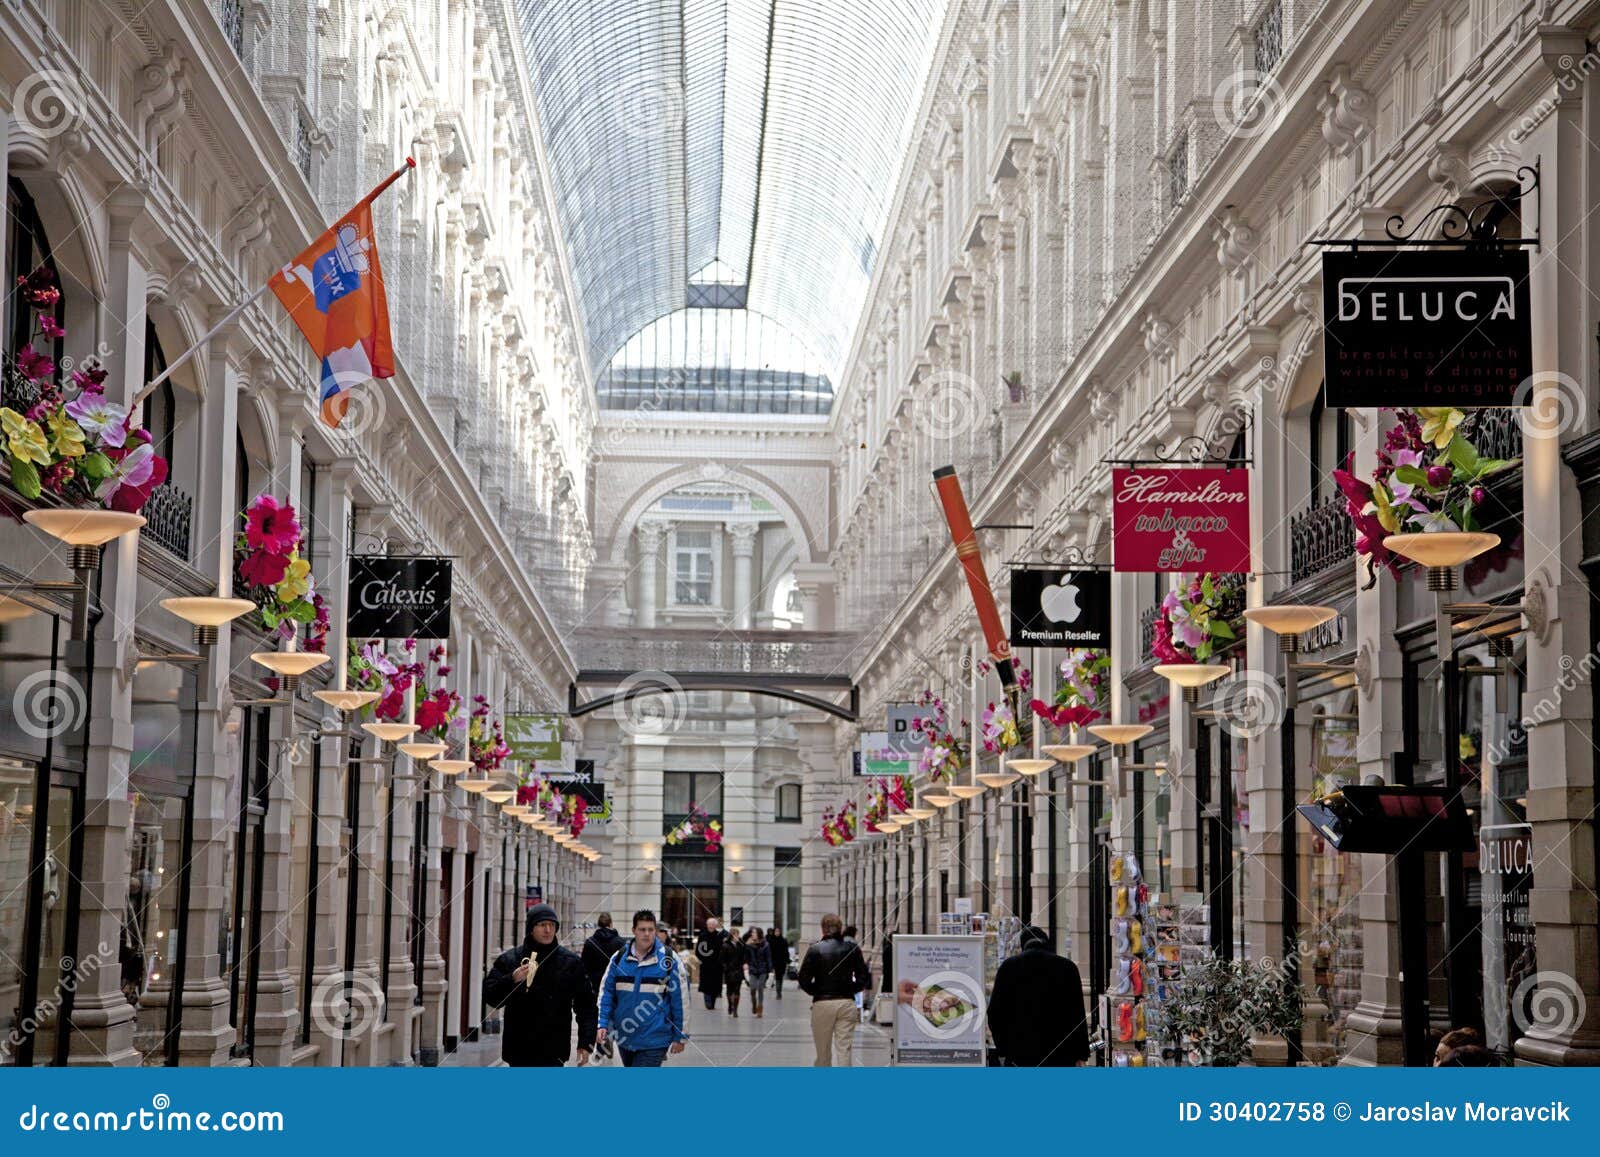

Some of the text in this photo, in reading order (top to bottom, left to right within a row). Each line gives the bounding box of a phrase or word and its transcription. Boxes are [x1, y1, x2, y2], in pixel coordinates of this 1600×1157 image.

[1338, 290, 1516, 322] DELUCA
[1341, 365, 1409, 379] wining
[1451, 363, 1518, 379] dining
[1117, 475, 1246, 503] Hamilton
[1135, 508, 1228, 532] tobacco
[1172, 529, 1191, 549] &
[1158, 541, 1207, 568] gifts
[360, 580, 437, 610] Calexis
[1021, 629, 1101, 641] Premium Reseller
[1479, 838, 1535, 875] DELUCA
